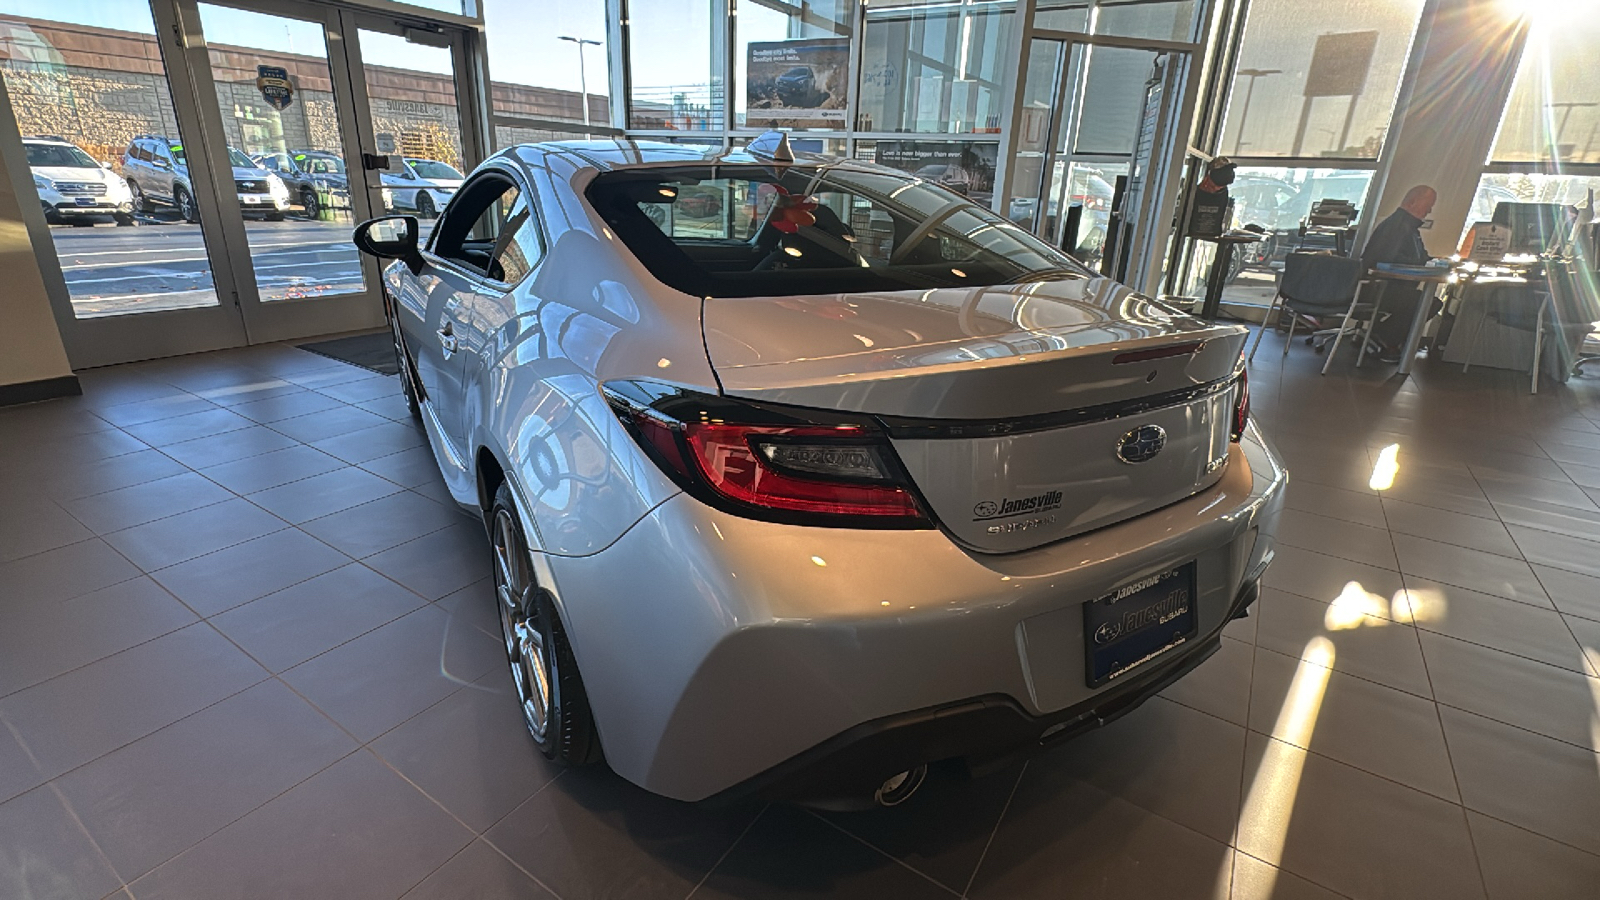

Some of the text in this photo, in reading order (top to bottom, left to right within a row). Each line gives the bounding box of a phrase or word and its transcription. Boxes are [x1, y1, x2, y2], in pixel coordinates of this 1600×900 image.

[914, 150, 933, 158] bigger
[998, 490, 1063, 515] Janesville
[1115, 574, 1161, 601] Janesville
[1119, 588, 1188, 636] Janesville
[1159, 605, 1189, 625] SUBARU
